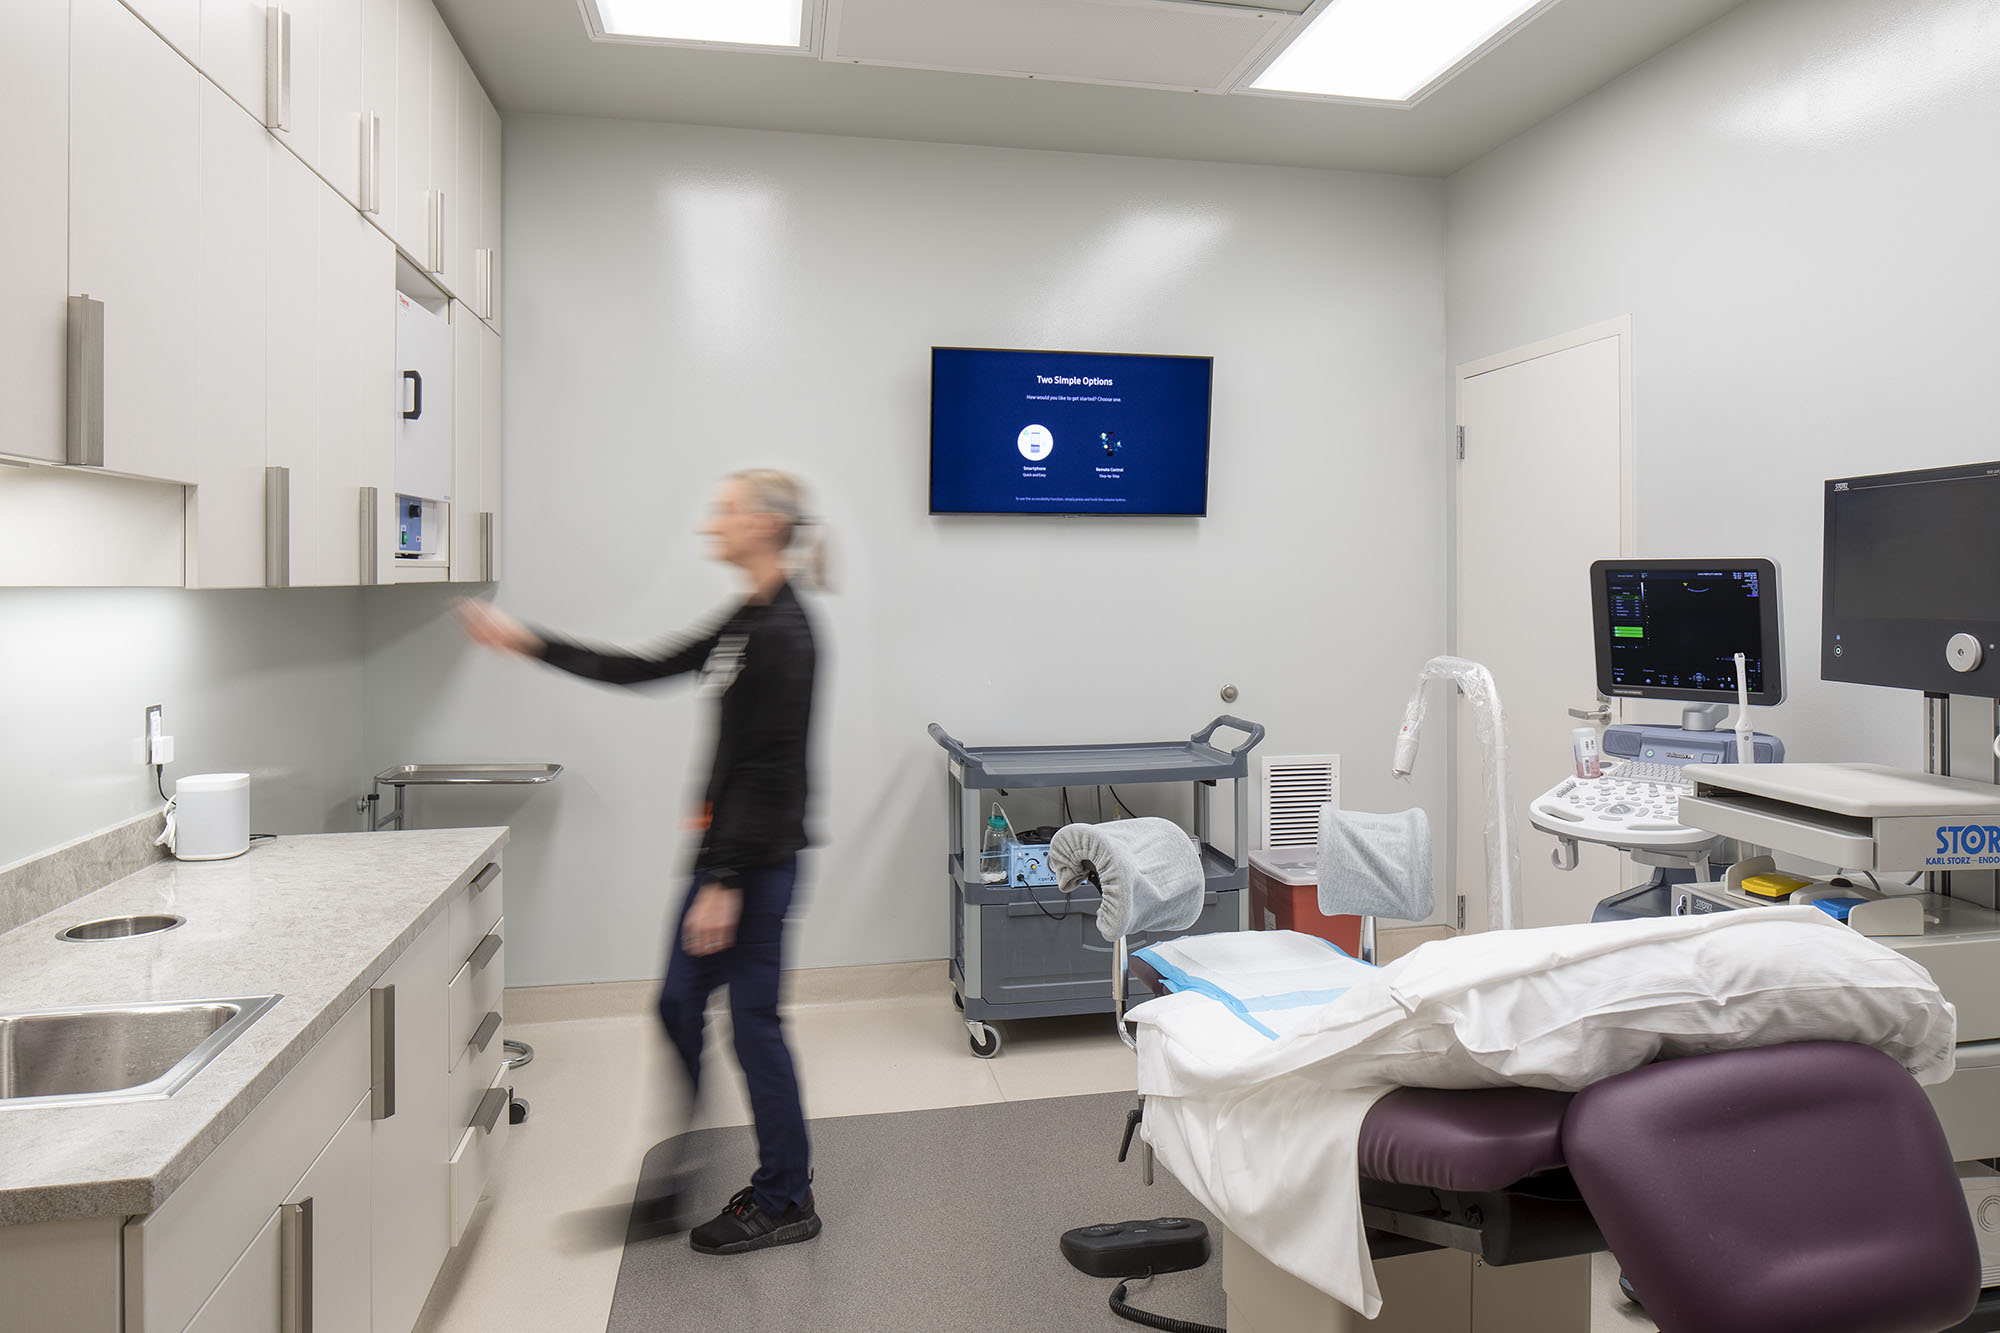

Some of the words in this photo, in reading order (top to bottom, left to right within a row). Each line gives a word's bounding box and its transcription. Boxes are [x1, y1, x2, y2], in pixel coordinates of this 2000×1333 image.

[1037, 375, 1053, 384] Two
[1054, 376, 1081, 386] Simple
[1082, 376, 1113, 387] Options
[1936, 825, 2000, 855] STOR
[1947, 856, 1971, 864] STORZ
